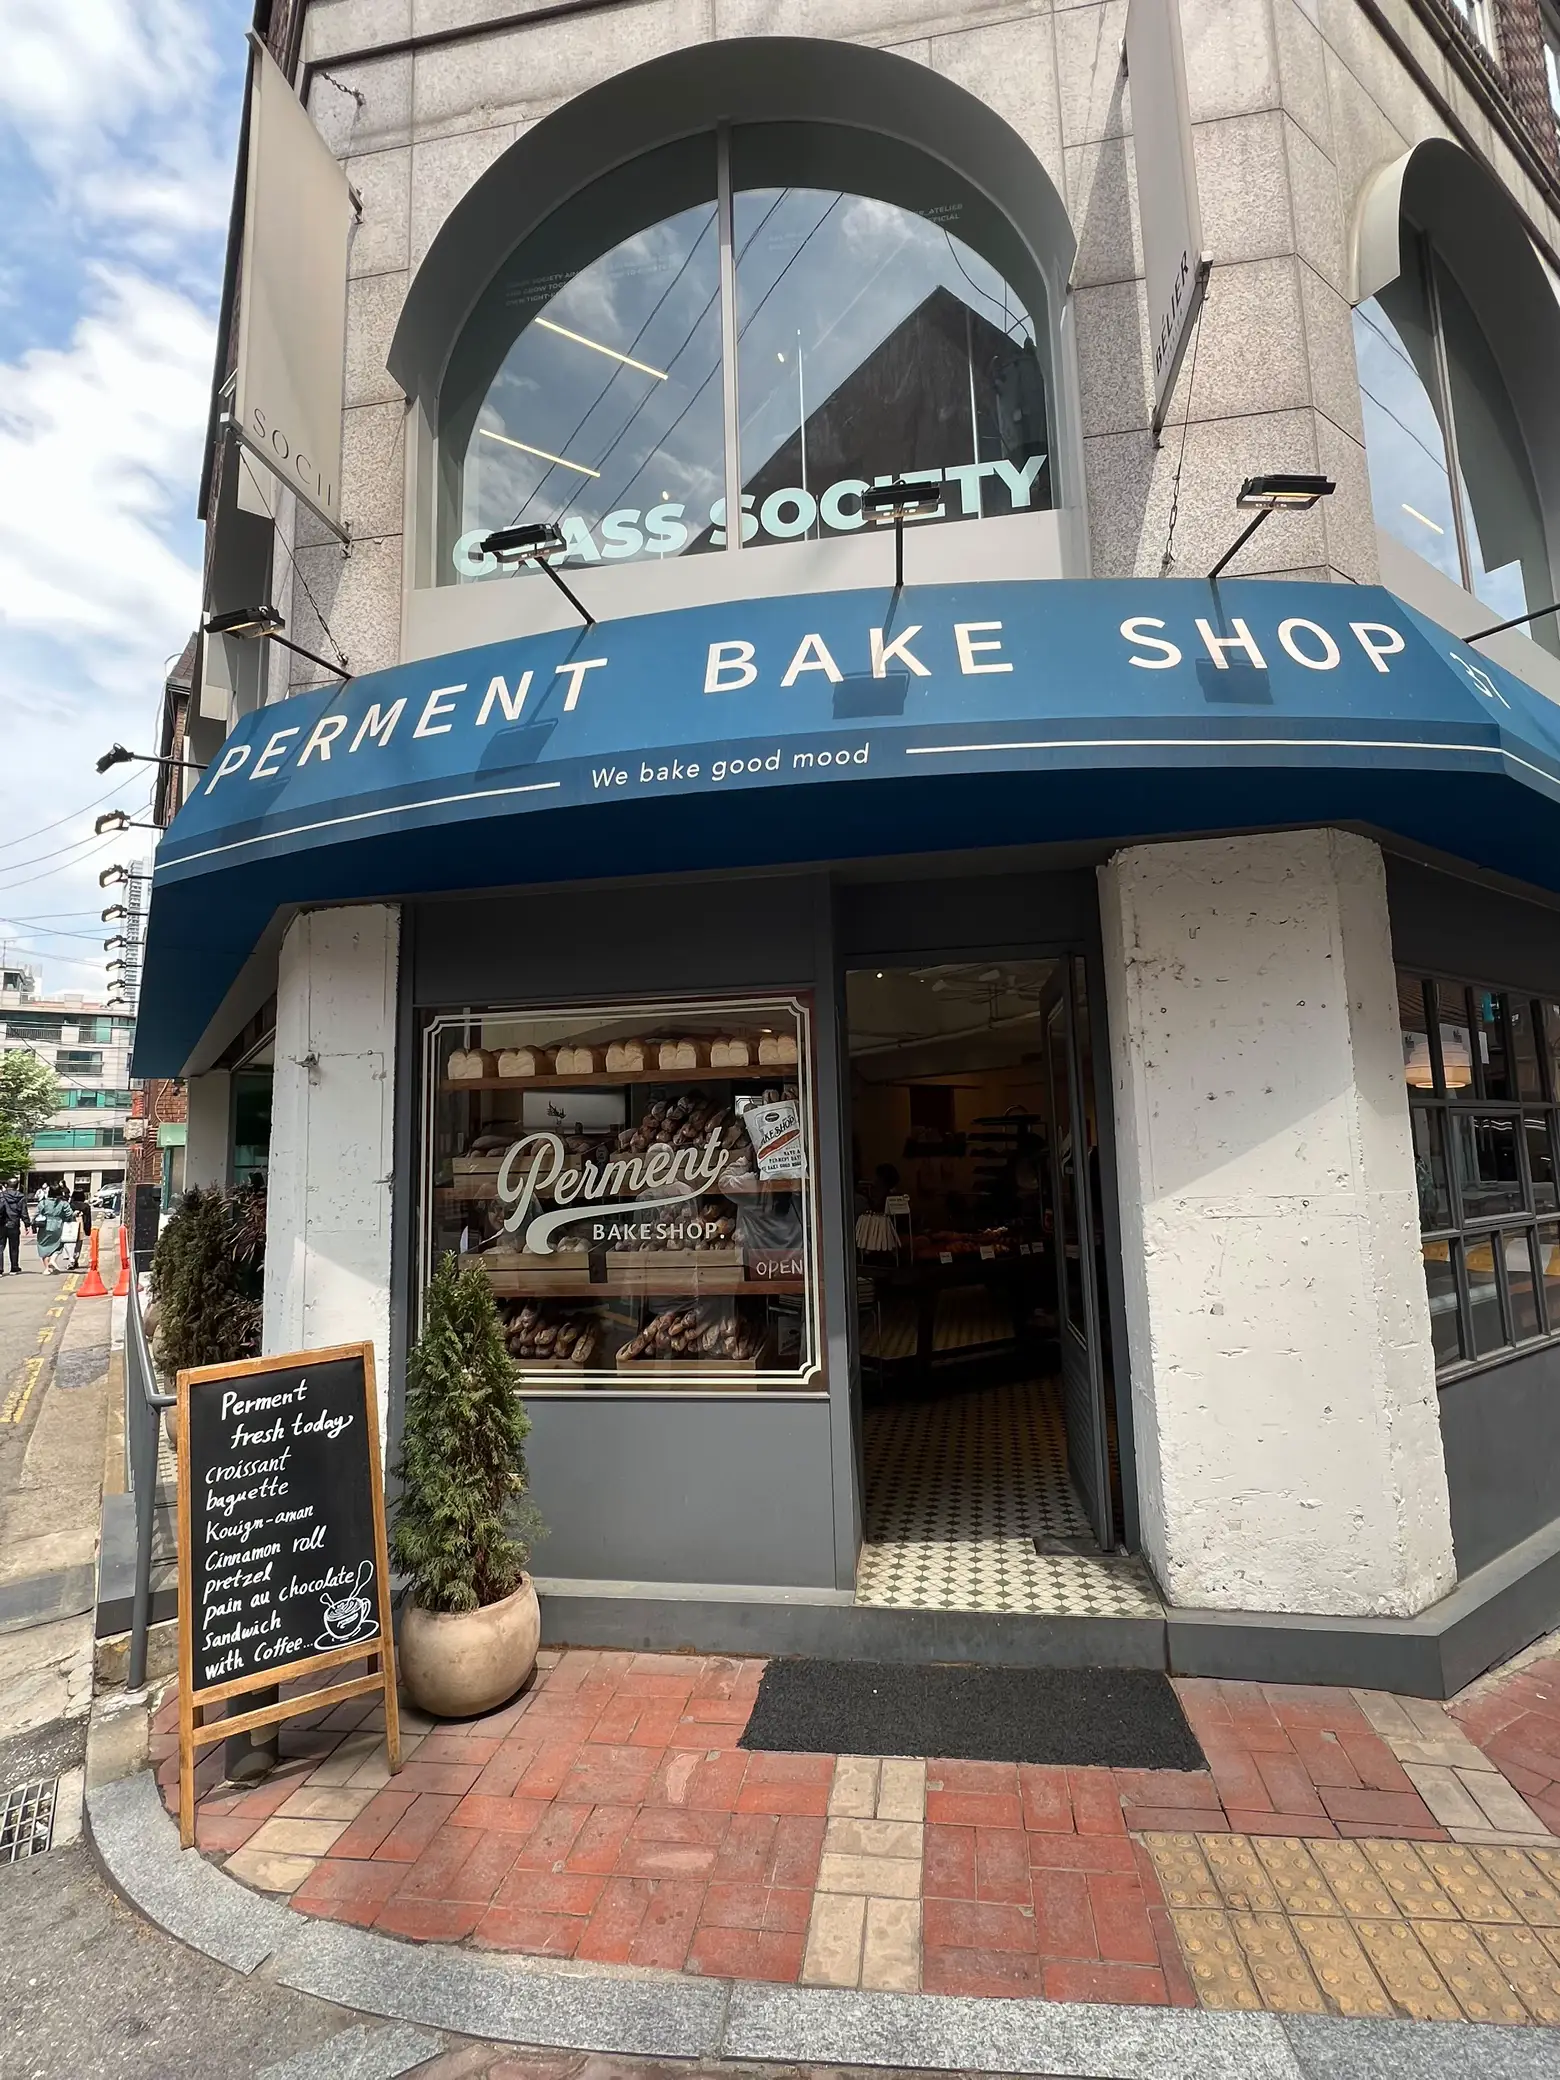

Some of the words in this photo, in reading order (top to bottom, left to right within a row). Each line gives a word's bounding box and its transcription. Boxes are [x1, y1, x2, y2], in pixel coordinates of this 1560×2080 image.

[203, 657, 608, 796] PERMENT
[703, 620, 1015, 695] BAKE
[1119, 616, 1406, 674] SHOP
[592, 767, 628, 789] We
[639, 759, 700, 783] bake
[711, 749, 782, 781] good
[792, 742, 870, 769] mood
[497, 1126, 730, 1234] Perment
[756, 1259, 803, 1279] OPEN
[221, 1378, 308, 1421] Perment
[230, 1417, 285, 1450] fresh
[291, 1409, 354, 1439] today
[205, 1476, 290, 1517] baguette
[292, 1525, 326, 1553] roll
[202, 1561, 274, 1605] pretzel
[202, 1597, 242, 1631] pain
[250, 1591, 271, 1608] au
[278, 1566, 356, 1602] chocolate
[204, 1649, 245, 1681] with
